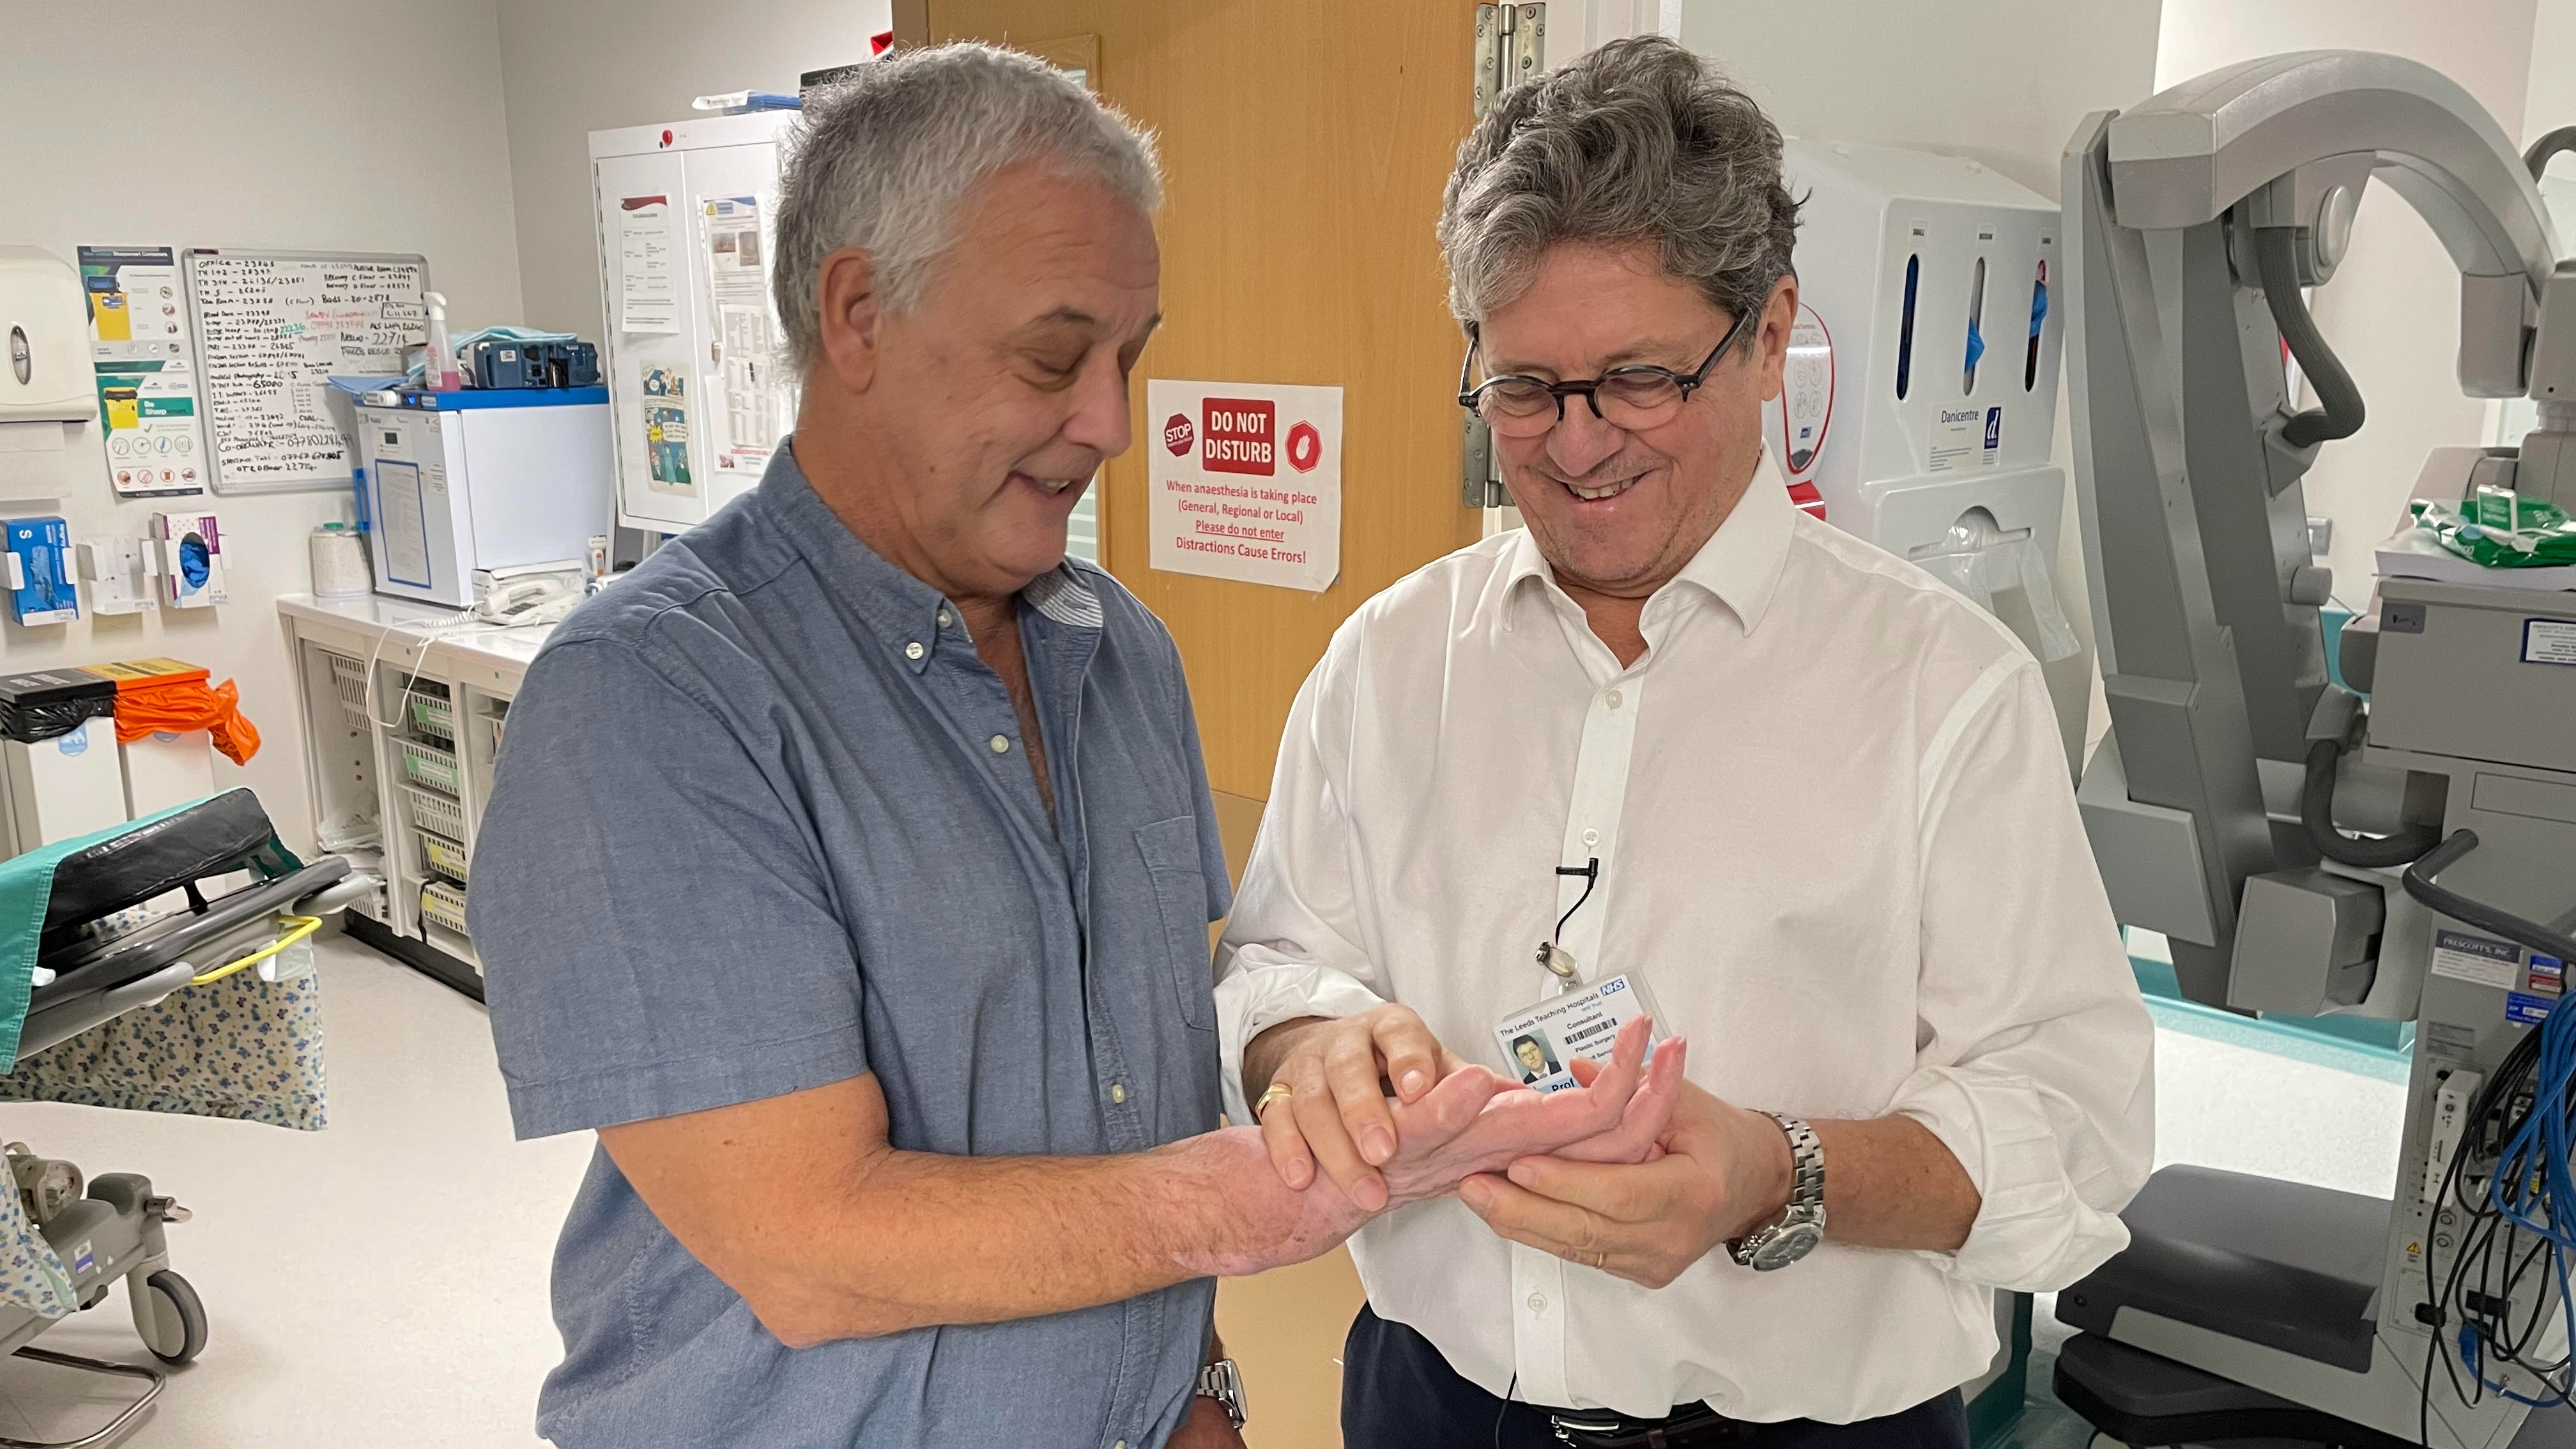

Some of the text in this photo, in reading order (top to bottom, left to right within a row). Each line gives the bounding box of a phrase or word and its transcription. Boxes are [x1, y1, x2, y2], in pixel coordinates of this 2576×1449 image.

[1211, 411, 1267, 434] DO NOT
[1942, 409, 1979, 423] Danicentre
[1166, 423, 1191, 442] STOP
[1206, 438, 1271, 463] DISTURB
[1167, 480, 1317, 505] When anaesthesia is taking place
[1178, 498, 1303, 525] (General, Regional or Local)
[19, 530, 32, 539] S
[1195, 519, 1284, 540] Please do not enter
[1176, 537, 1306, 564] Distractions Cause Errors!
[1514, 1020, 1535, 1031] Leeds
[1535, 1007, 1567, 1022] Teaching
[1567, 992, 1599, 1009] Hospitals
[1600, 979, 1625, 995] NHS
[1567, 1011, 1603, 1029] Consultant
[1575, 1043, 1593, 1052] Plastic
[1552, 1078, 1575, 1091] Prof
